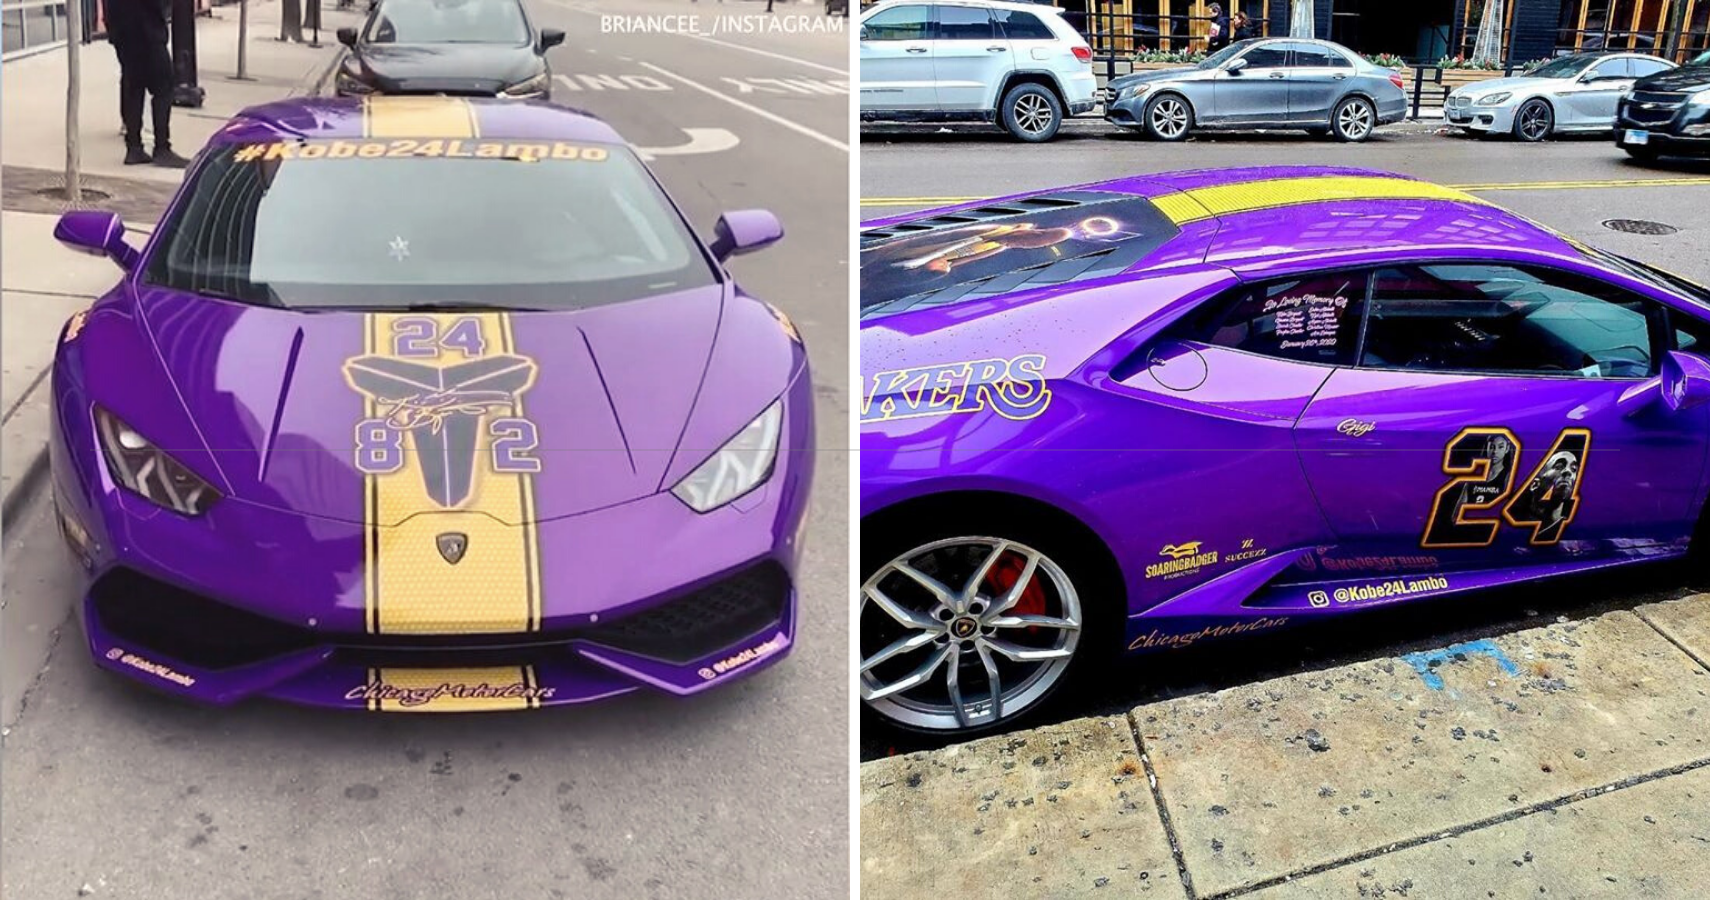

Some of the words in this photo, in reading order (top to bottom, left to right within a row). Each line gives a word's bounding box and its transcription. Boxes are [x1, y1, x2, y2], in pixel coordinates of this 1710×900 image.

[233, 138, 609, 163] #Kobe24Lambo
[392, 317, 486, 358] 24
[860, 354, 1053, 424] KERS
[355, 419, 403, 473] 8
[489, 418, 542, 473] 2
[1336, 418, 1376, 437] Gigi
[1420, 427, 1592, 548] 24
[1145, 551, 1218, 579] SOARINGBADGER
[1333, 576, 1449, 603] @Kobe24Lambo
